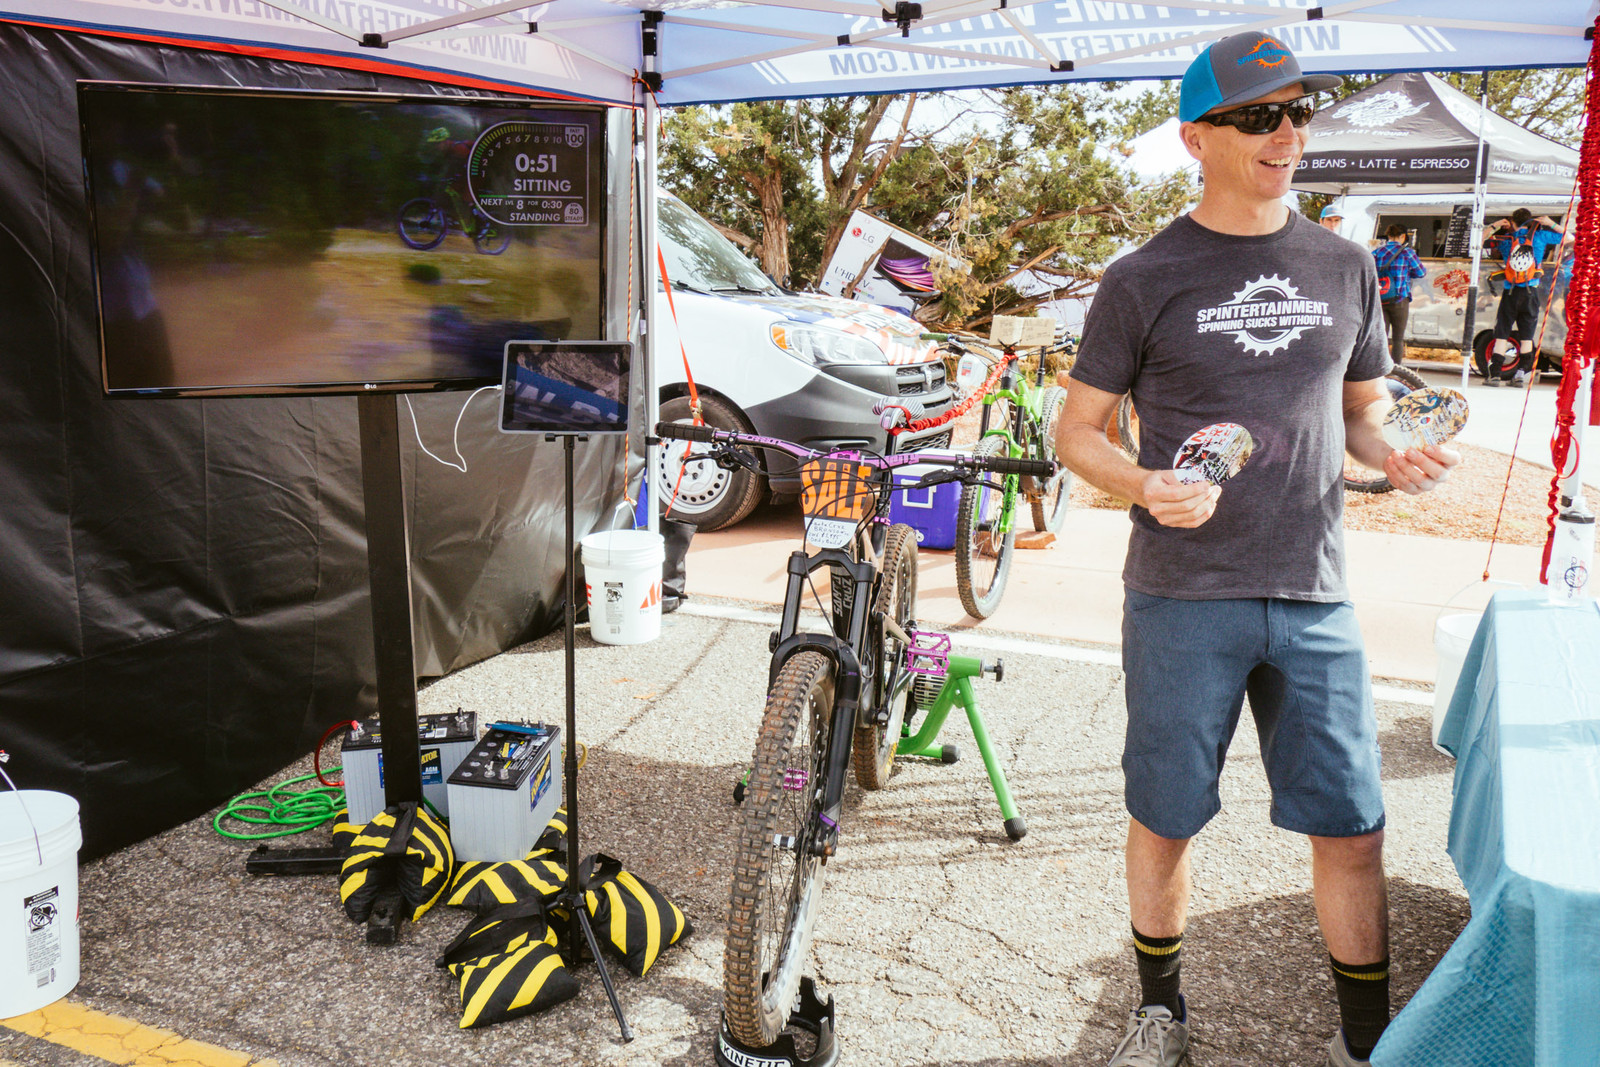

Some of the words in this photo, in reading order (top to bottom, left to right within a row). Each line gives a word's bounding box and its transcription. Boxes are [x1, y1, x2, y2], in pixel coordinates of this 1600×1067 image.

[505, 136, 511, 144] 5
[515, 135, 521, 143] 6
[523, 134, 531, 143] 7
[533, 135, 540, 144] 8
[543, 136, 550, 144] 9
[552, 136, 562, 144] 10
[566, 134, 584, 143] 100
[495, 141, 501, 149] 4
[488, 149, 494, 157] 3
[482, 158, 488, 166] 2
[515, 153, 557, 173] 0:51
[1312, 158, 1347, 169] BEANS
[1359, 158, 1398, 169] LATTE
[1410, 158, 1470, 169] ESPRESSO
[1492, 160, 1514, 172] MOCHA
[1538, 163, 1555, 176] COLD
[480, 170, 486, 178] 1
[513, 178, 572, 192] SITTING
[480, 198, 503, 206] NEXT
[516, 200, 524, 210] 8
[541, 200, 563, 209] 0:30
[509, 212, 561, 222] STANDING
[862, 232, 875, 244] LG
[1197, 300, 1329, 323] SPINTERTAINMENT
[1197, 319, 1244, 334] SPINNING
[1245, 316, 1278, 329] SUCKS
[1279, 314, 1322, 327] WITHOUT
[1322, 315, 1333, 326] US
[801, 460, 872, 520] SALE
[841, 577, 853, 610] CRUZ
